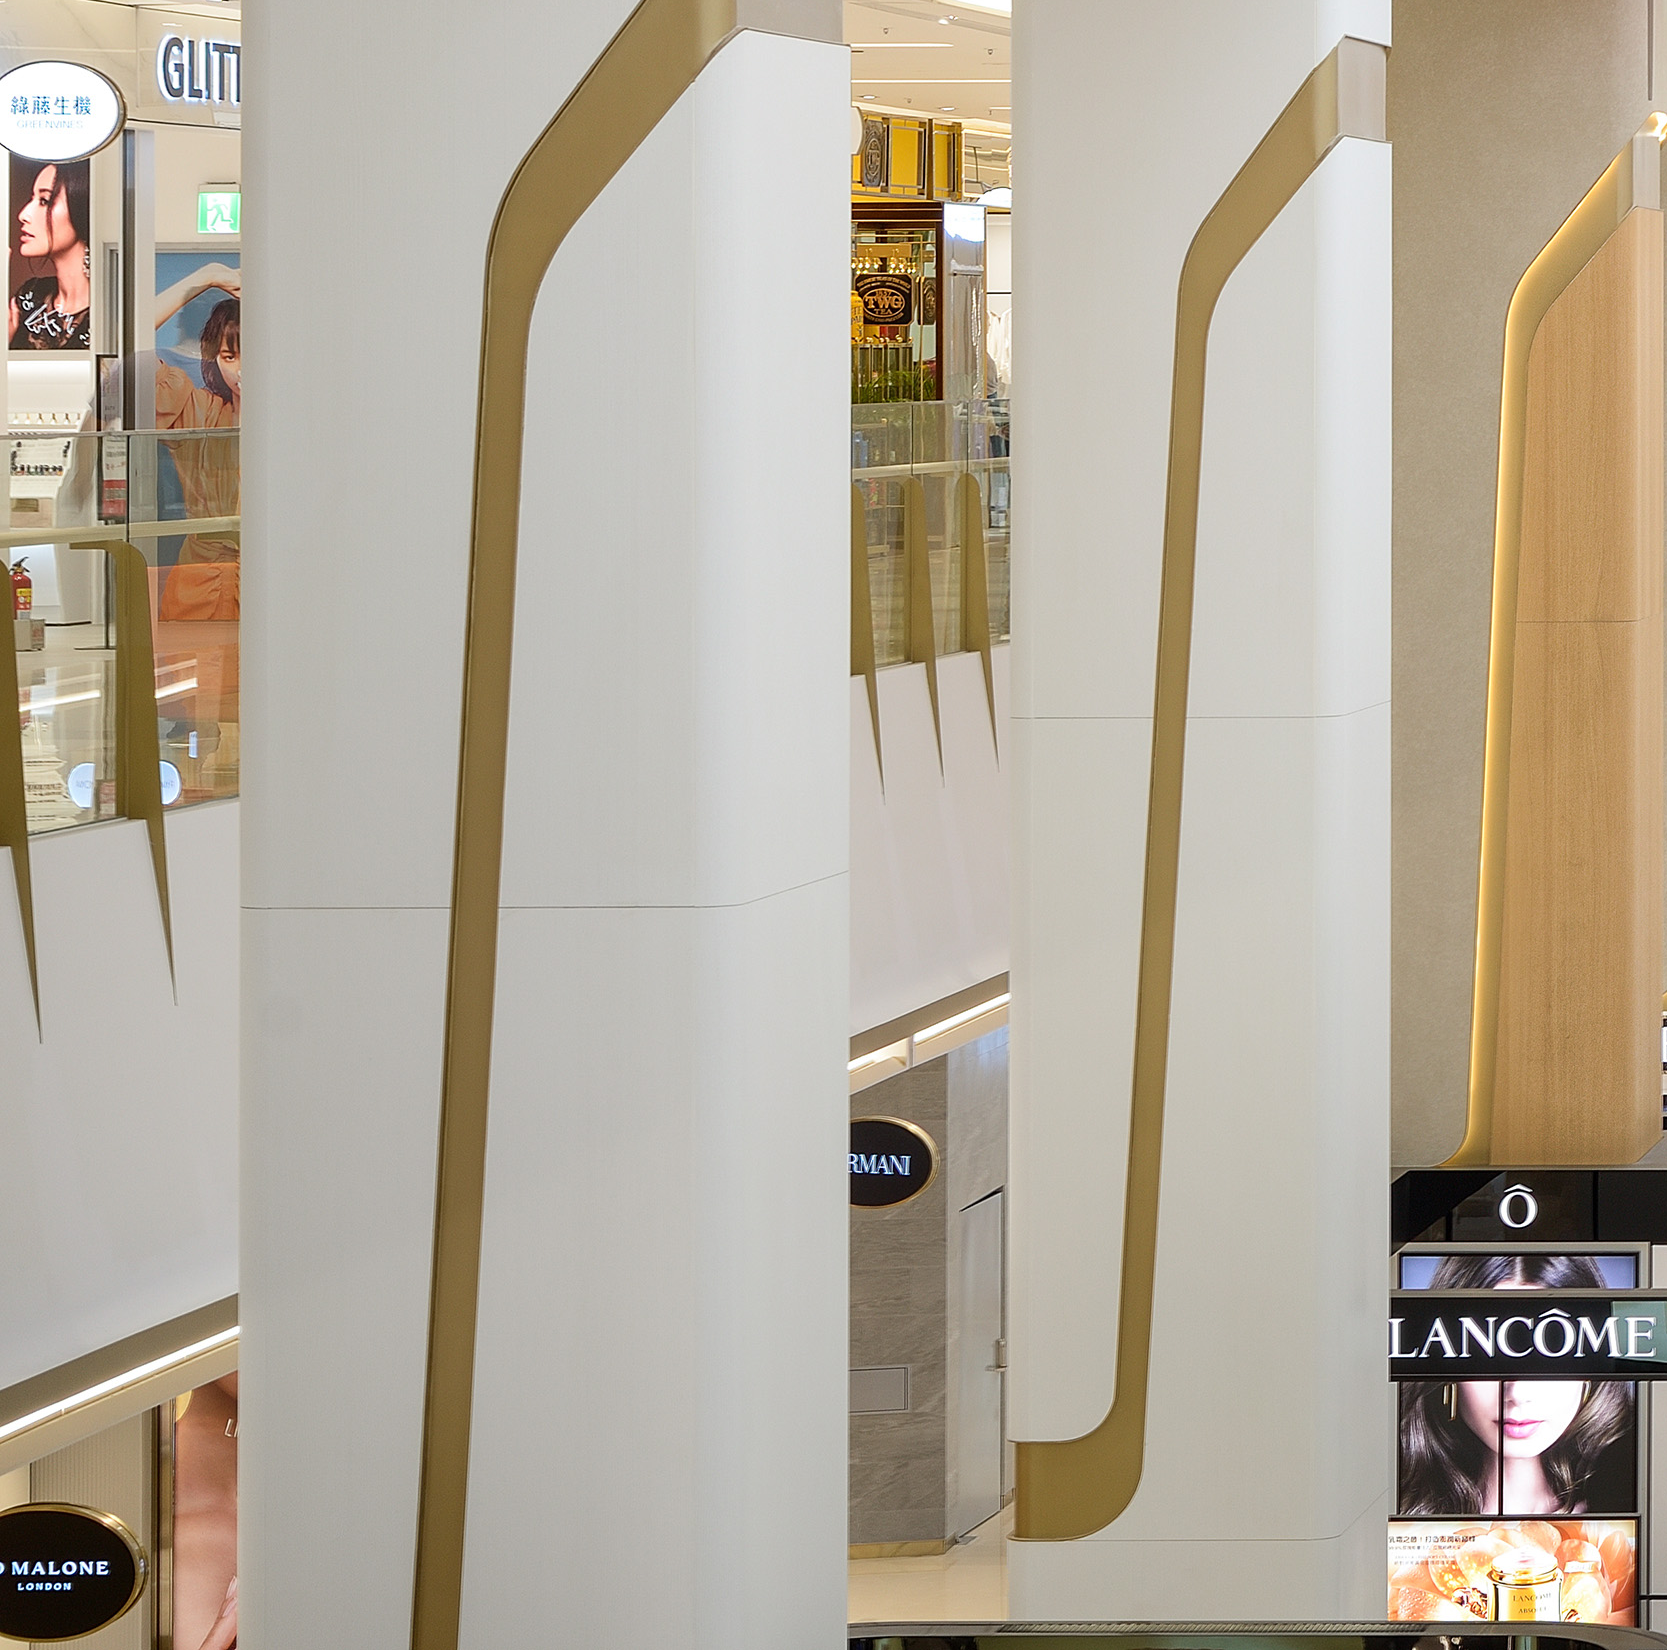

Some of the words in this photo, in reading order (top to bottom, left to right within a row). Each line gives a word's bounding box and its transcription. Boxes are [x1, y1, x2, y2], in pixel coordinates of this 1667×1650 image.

[17, 120, 84, 129] GREENVINES
[865, 295, 903, 309] TWG
[1499, 1183, 1538, 1229] Ô
[1388, 1307, 1657, 1359] LANCÔME
[11, 1560, 109, 1576] MALONE
[17, 1582, 72, 1591] LONDON
